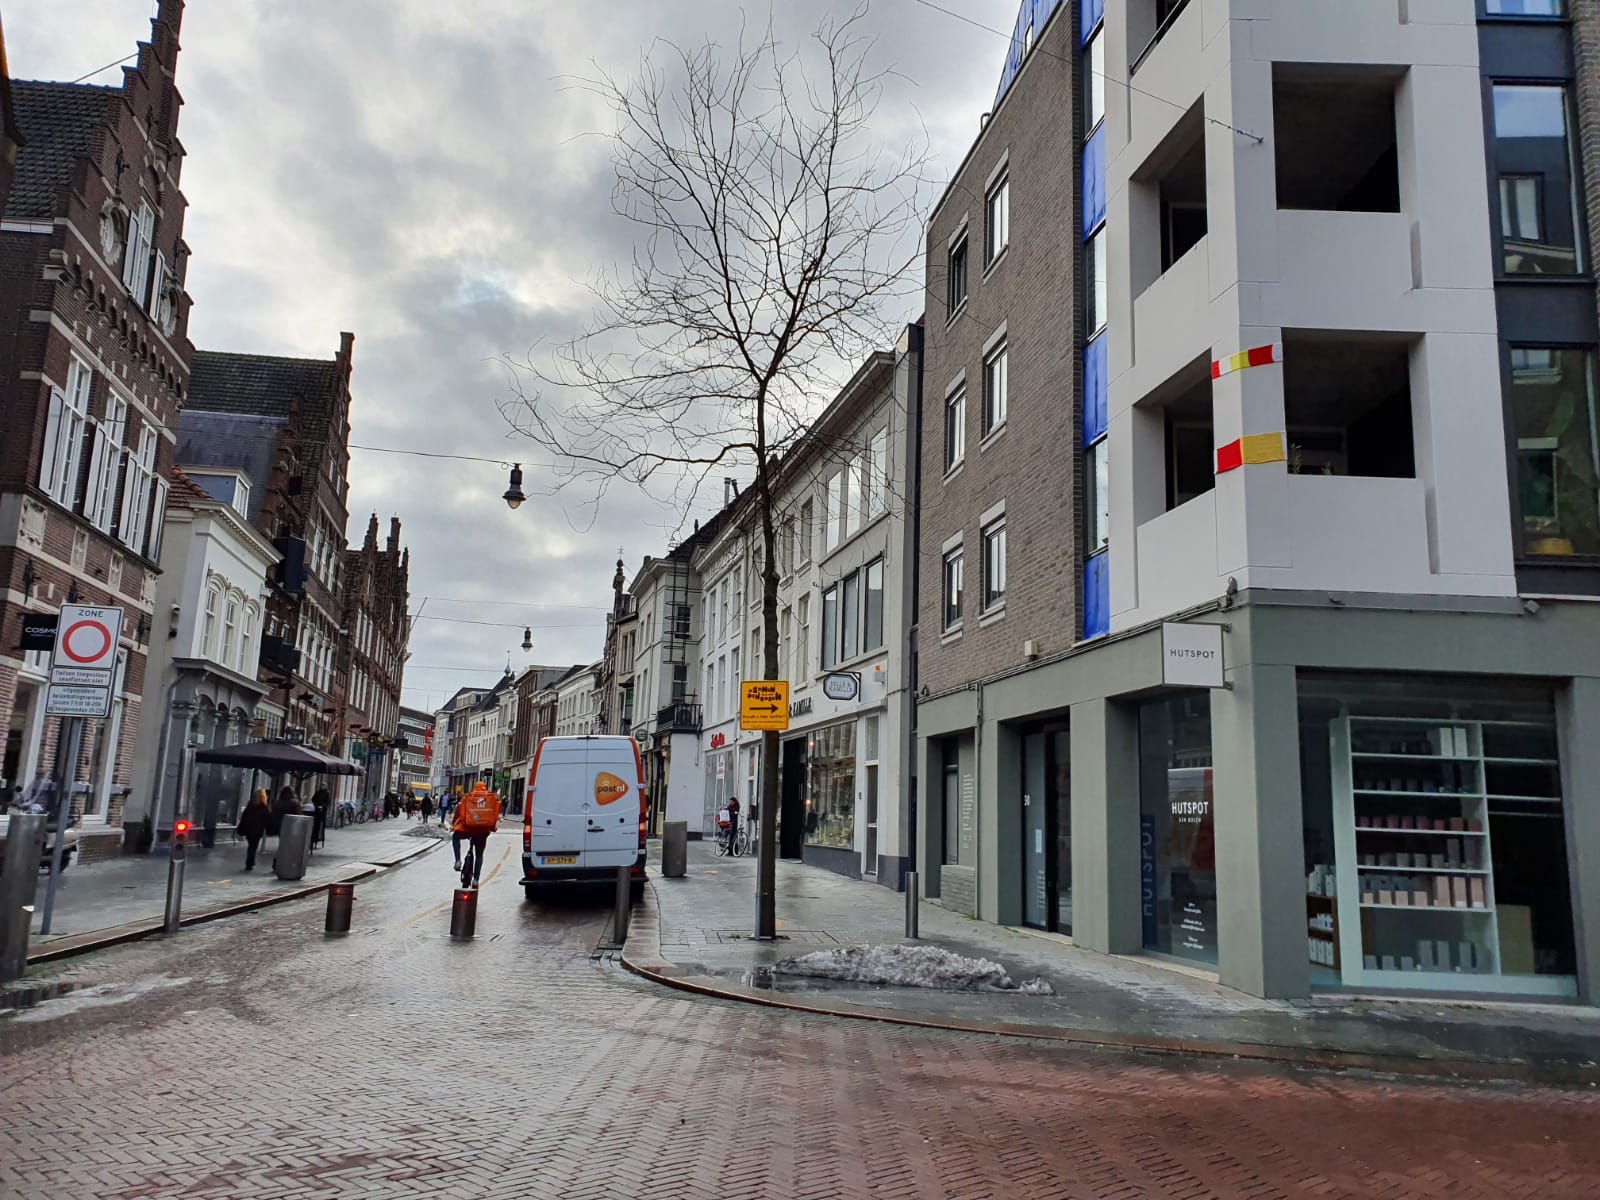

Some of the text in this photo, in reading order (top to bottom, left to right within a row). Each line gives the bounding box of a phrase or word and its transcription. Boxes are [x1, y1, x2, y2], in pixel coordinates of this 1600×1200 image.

[78, 609, 104, 618] ZONE
[1170, 649, 1215, 659] HUTSPOT
[422, 725, 433, 763] HEMA
[1024, 794, 1031, 806] 30
[1171, 801, 1208, 815] HUTSPOT
